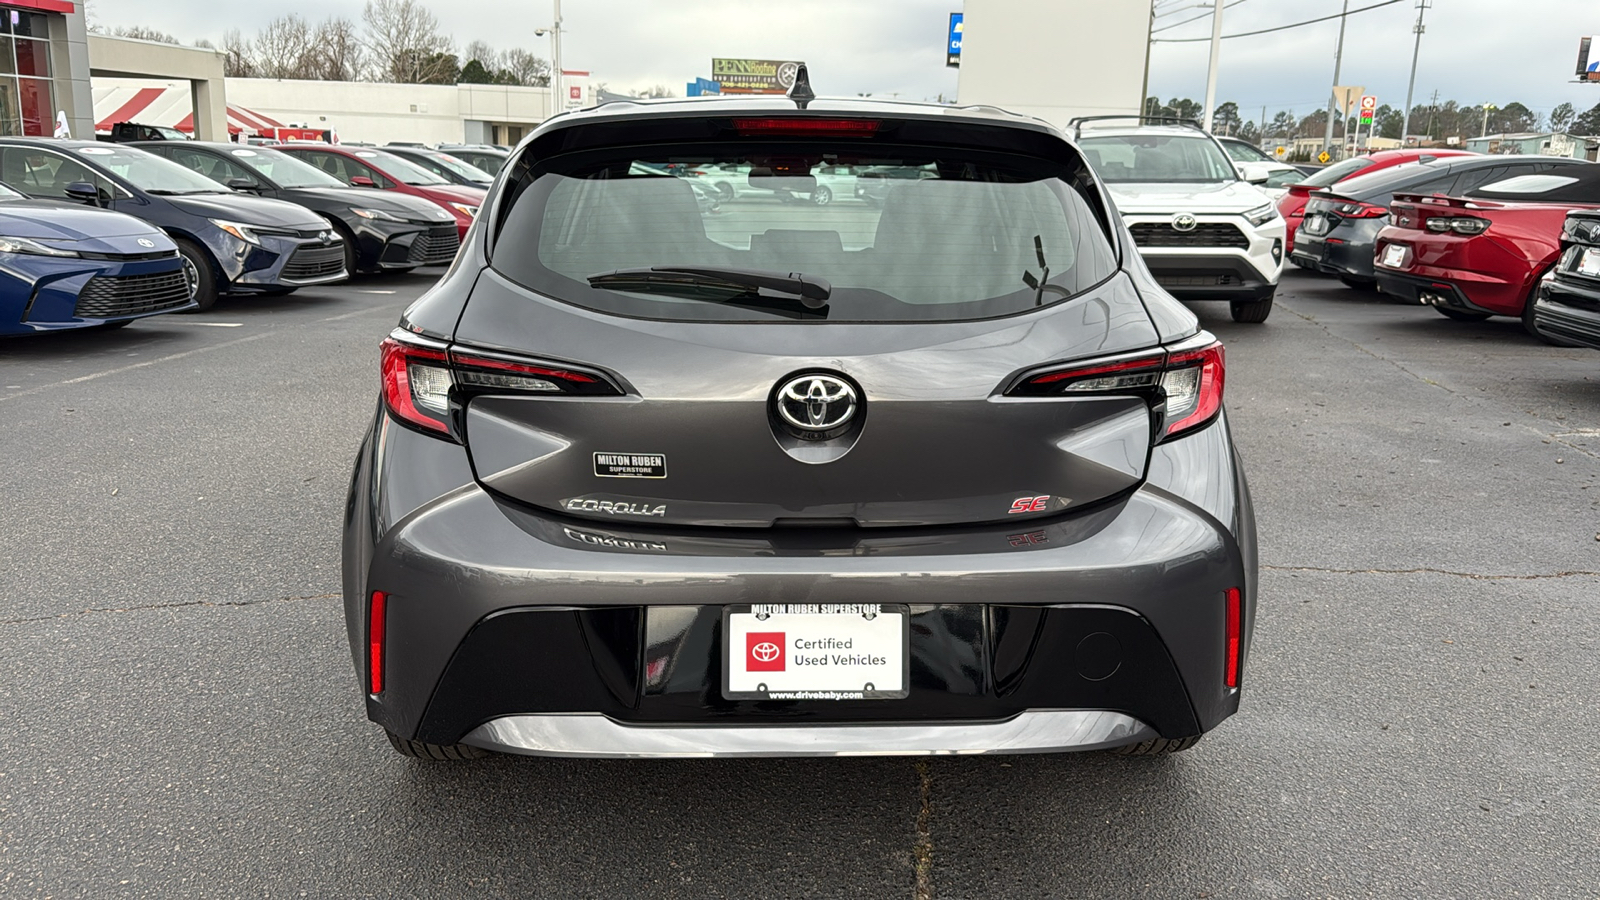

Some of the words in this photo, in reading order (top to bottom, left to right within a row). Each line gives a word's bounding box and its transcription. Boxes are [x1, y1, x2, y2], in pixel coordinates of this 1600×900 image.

[714, 60, 751, 73] PENN
[751, 62, 776, 76] Roofing
[597, 455, 630, 466] MILTON
[632, 456, 662, 467] RUBEN
[567, 499, 667, 516] COROLLA
[1008, 495, 1050, 513] SE
[751, 604, 786, 613] MILTON
[788, 604, 819, 613] RUBEN
[821, 604, 881, 613] SUPERSTORE
[794, 638, 853, 649] Certified
[794, 655, 828, 665] Used
[832, 655, 886, 665] Vehicles
[769, 691, 863, 700] www.drivebaby.com
